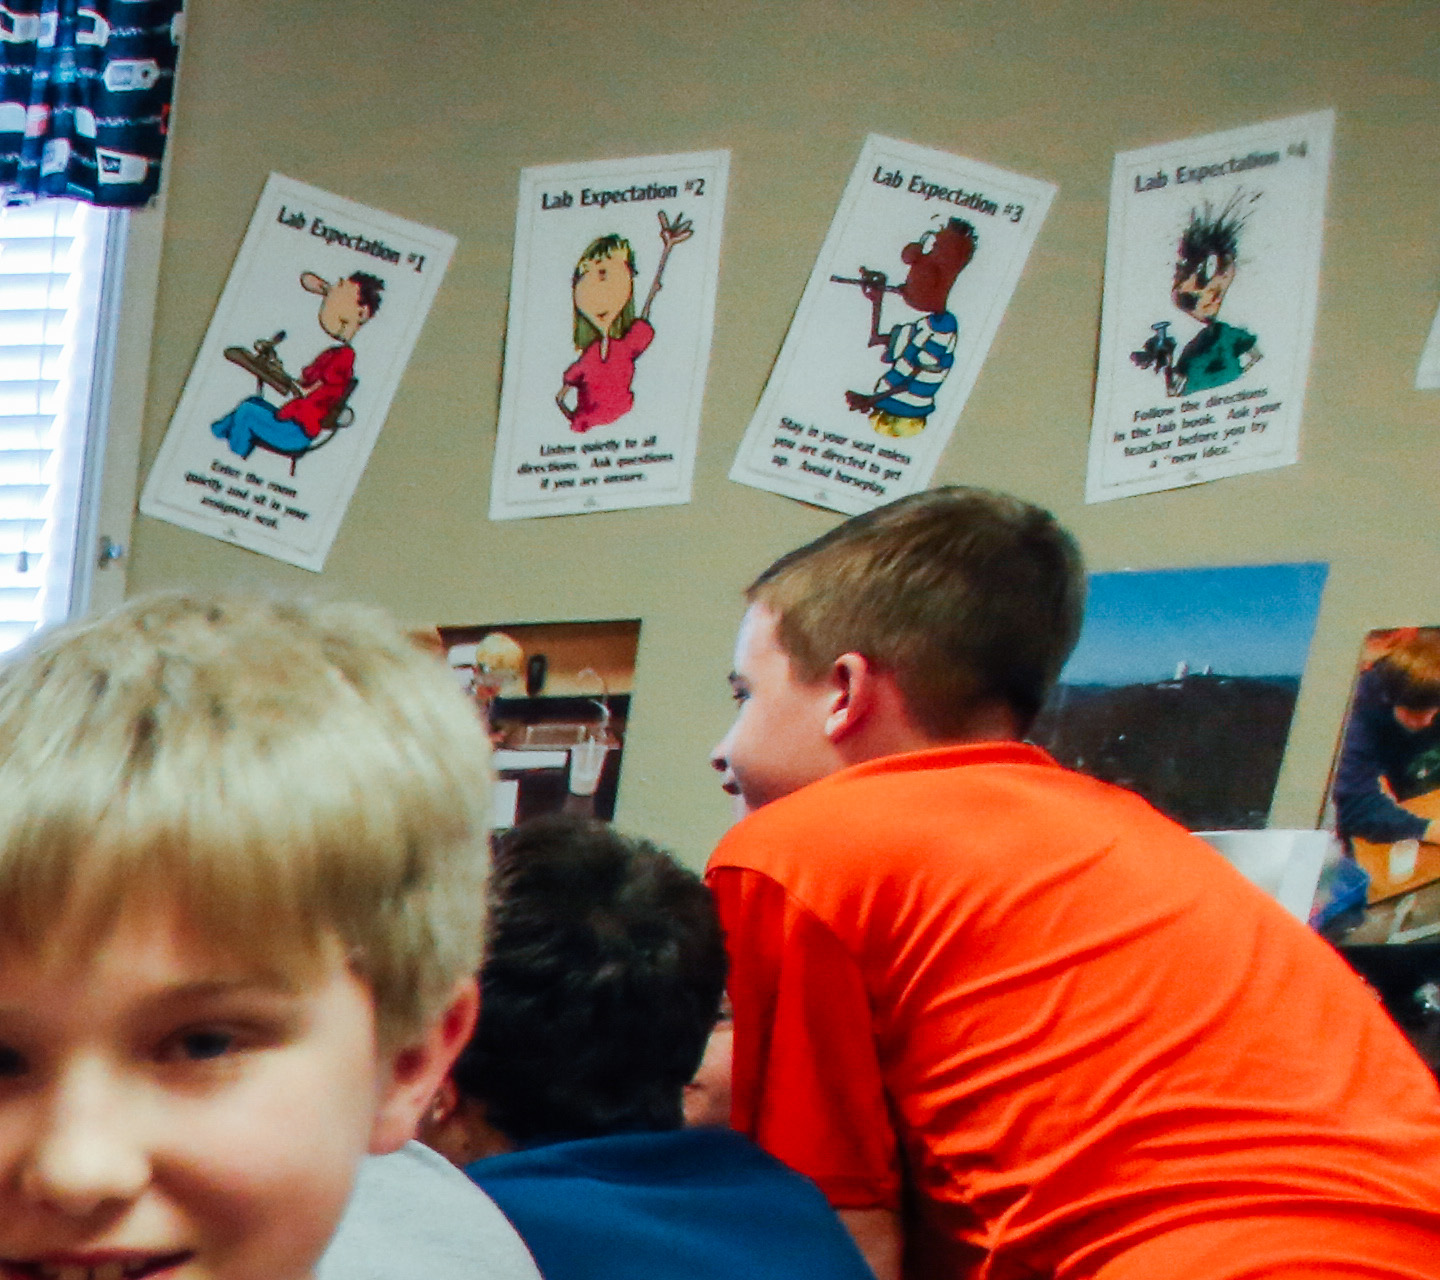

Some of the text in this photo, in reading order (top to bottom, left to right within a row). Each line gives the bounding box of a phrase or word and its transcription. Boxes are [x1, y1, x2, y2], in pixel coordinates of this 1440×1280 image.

[542, 178, 705, 209] Lab Expectation #2
[873, 166, 1024, 222] Lab Expectation #3
[1135, 170, 1168, 193] Lab
[1177, 151, 1279, 184] Expectation
[277, 205, 306, 230] Lab
[311, 217, 400, 265] Expectation
